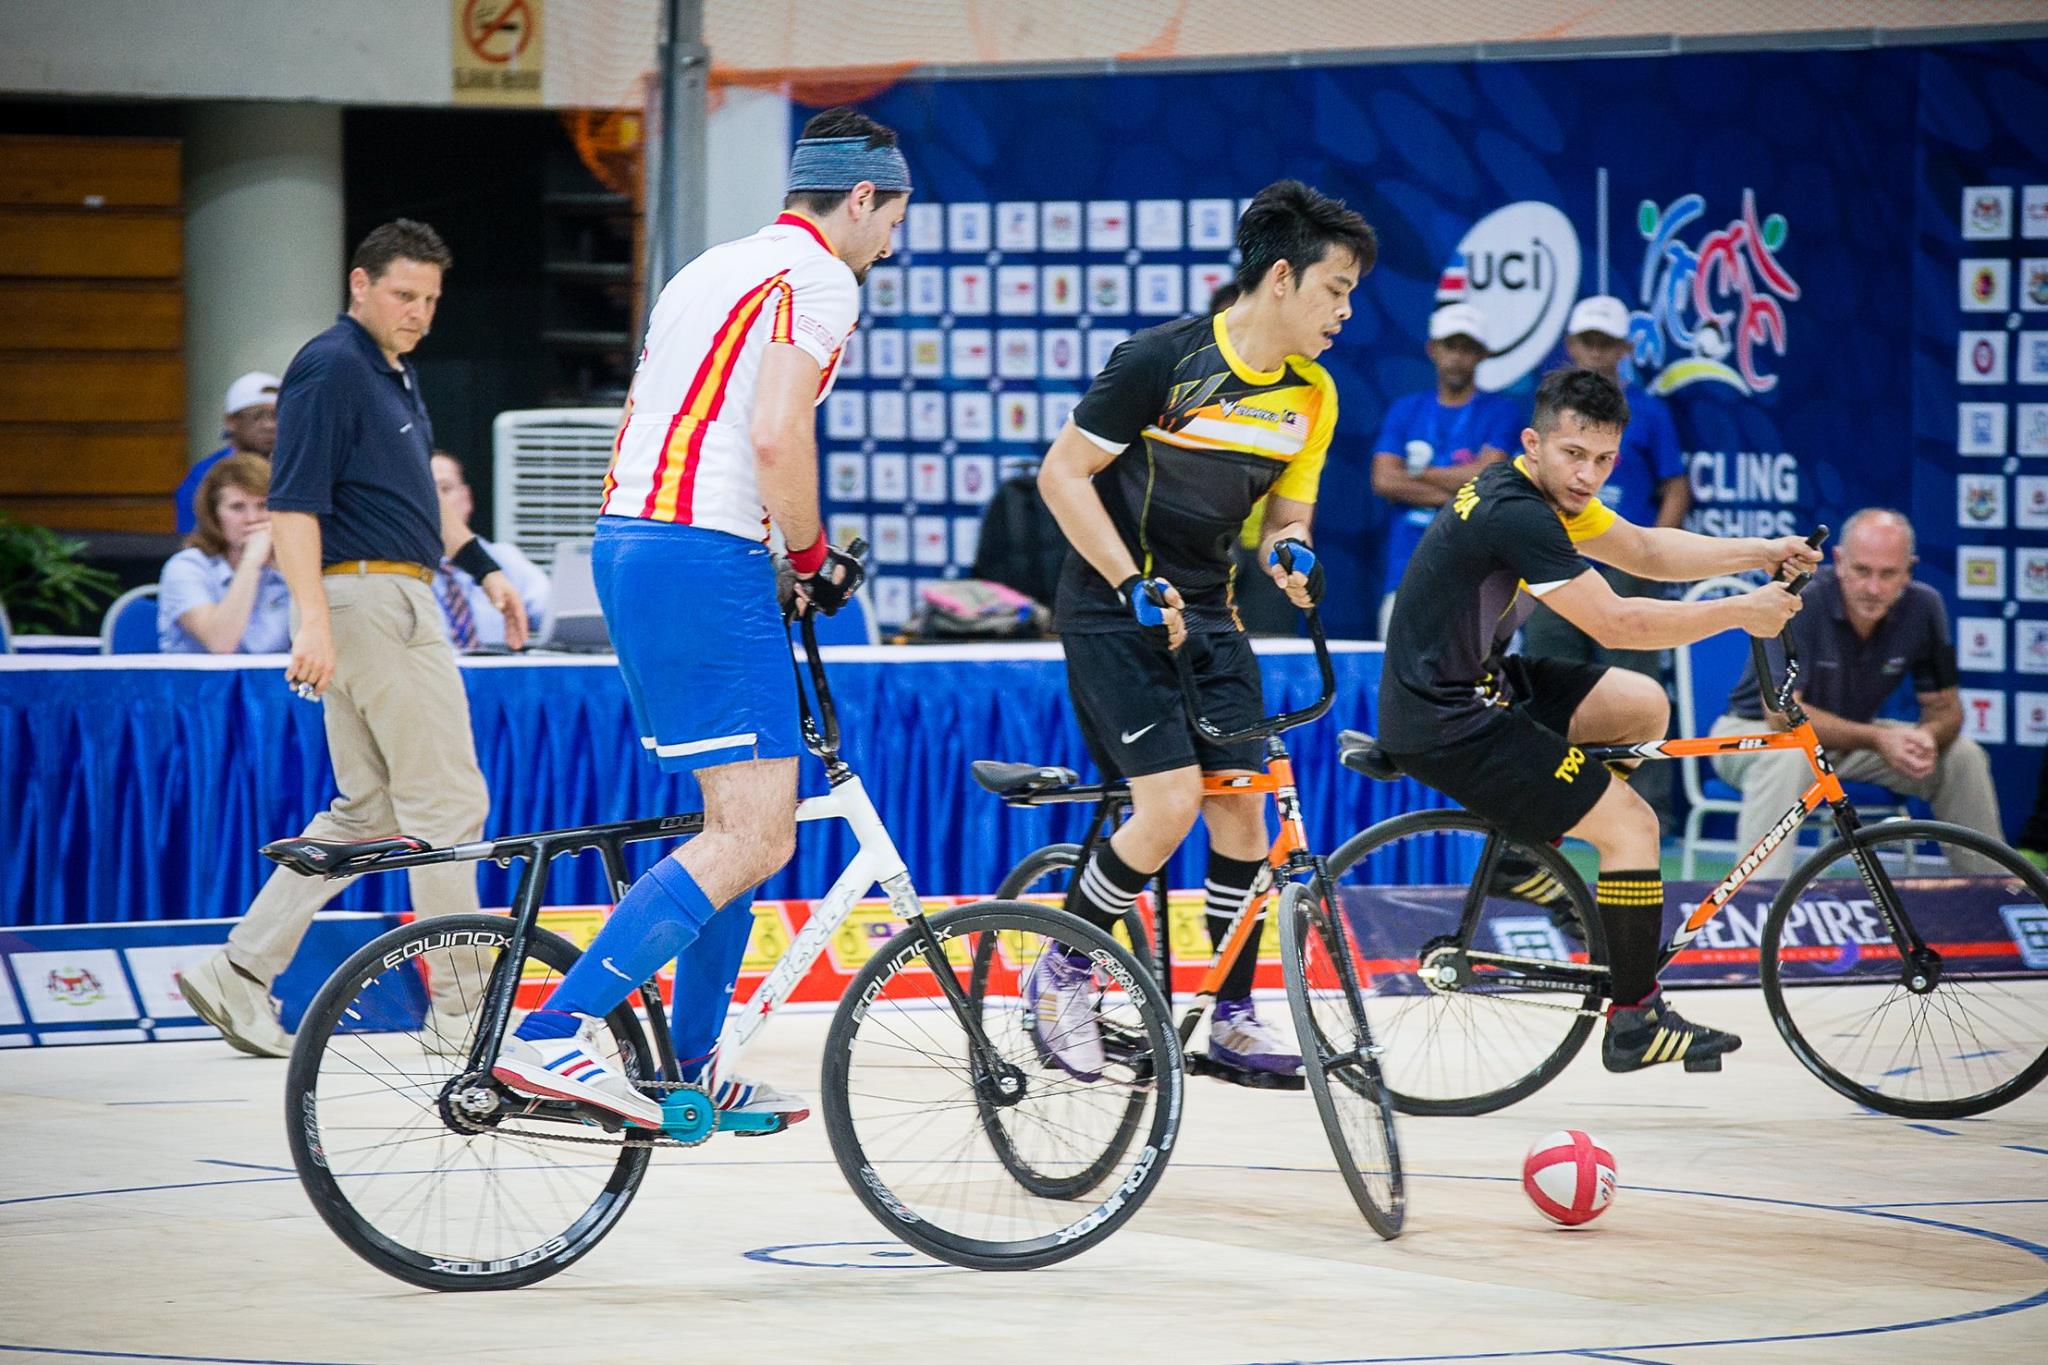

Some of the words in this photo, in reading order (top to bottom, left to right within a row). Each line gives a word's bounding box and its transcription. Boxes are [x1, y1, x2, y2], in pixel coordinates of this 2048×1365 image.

[1681, 451, 1798, 502] CLING
[1555, 746, 1586, 784] T90
[383, 930, 514, 970] EQUINOX
